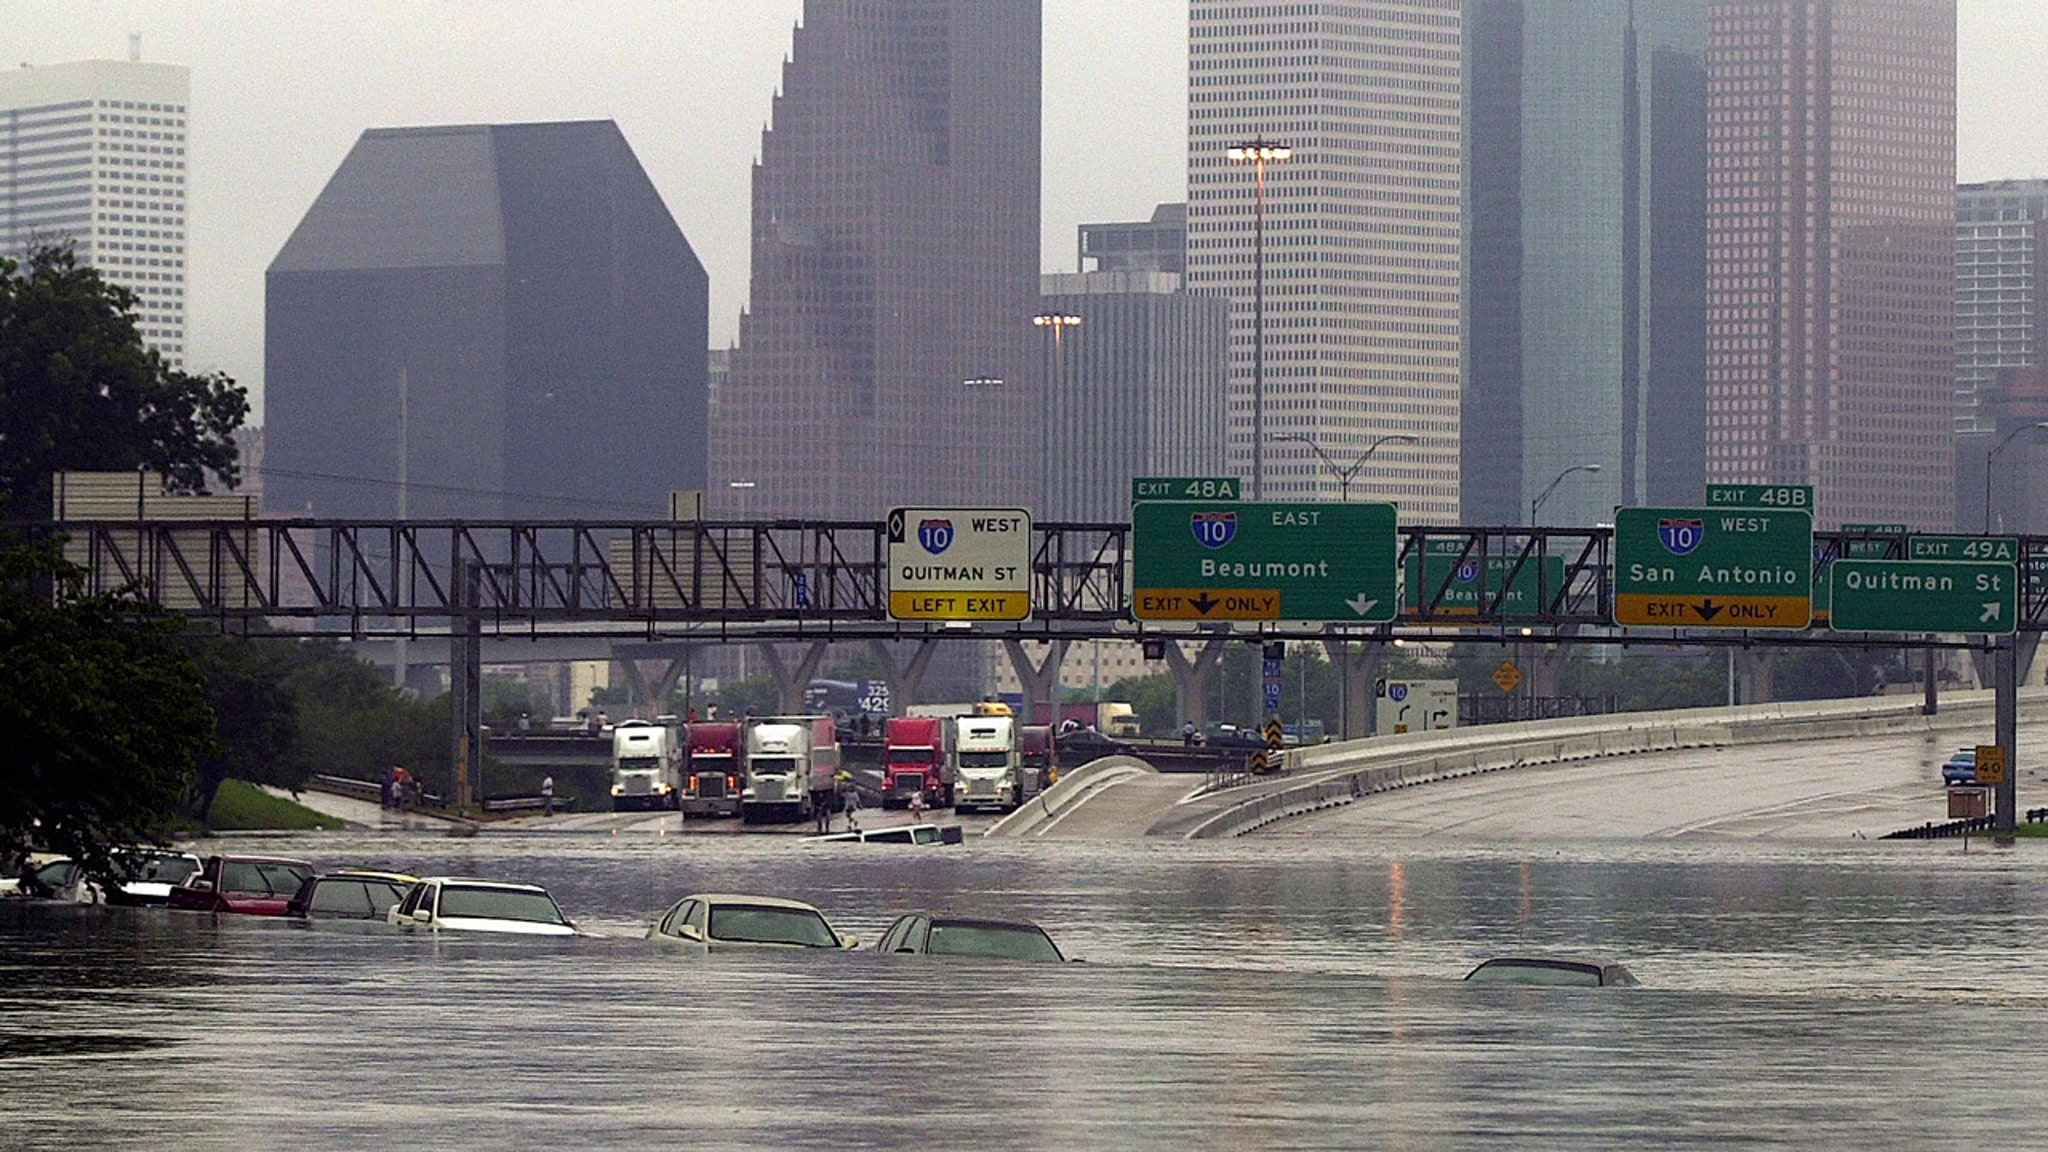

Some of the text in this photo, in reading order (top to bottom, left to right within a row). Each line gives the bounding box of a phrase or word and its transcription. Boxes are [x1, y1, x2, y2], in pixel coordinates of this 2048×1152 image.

[1137, 481, 1235, 498] EXIT 48A
[1712, 488, 1806, 506] EXIT 48B
[925, 518, 1021, 549] 10 WEST
[1202, 511, 1320, 542] 10 EAST
[1668, 517, 1770, 548] 10 WEST
[1916, 542, 2011, 559] EXIT 49A
[901, 566, 1017, 581] QUITMAN ST
[1201, 559, 1329, 577] Beaumont
[1630, 564, 1797, 584] San Antonio
[1846, 571, 2001, 592] Quitman St
[1444, 588, 1523, 601] Beamnt
[911, 598, 1006, 612] LEFT EXIT
[1143, 597, 1274, 611] EXIT ONLY
[1647, 603, 1777, 618] EXIT ONLY
[1979, 762, 2001, 774] 40
